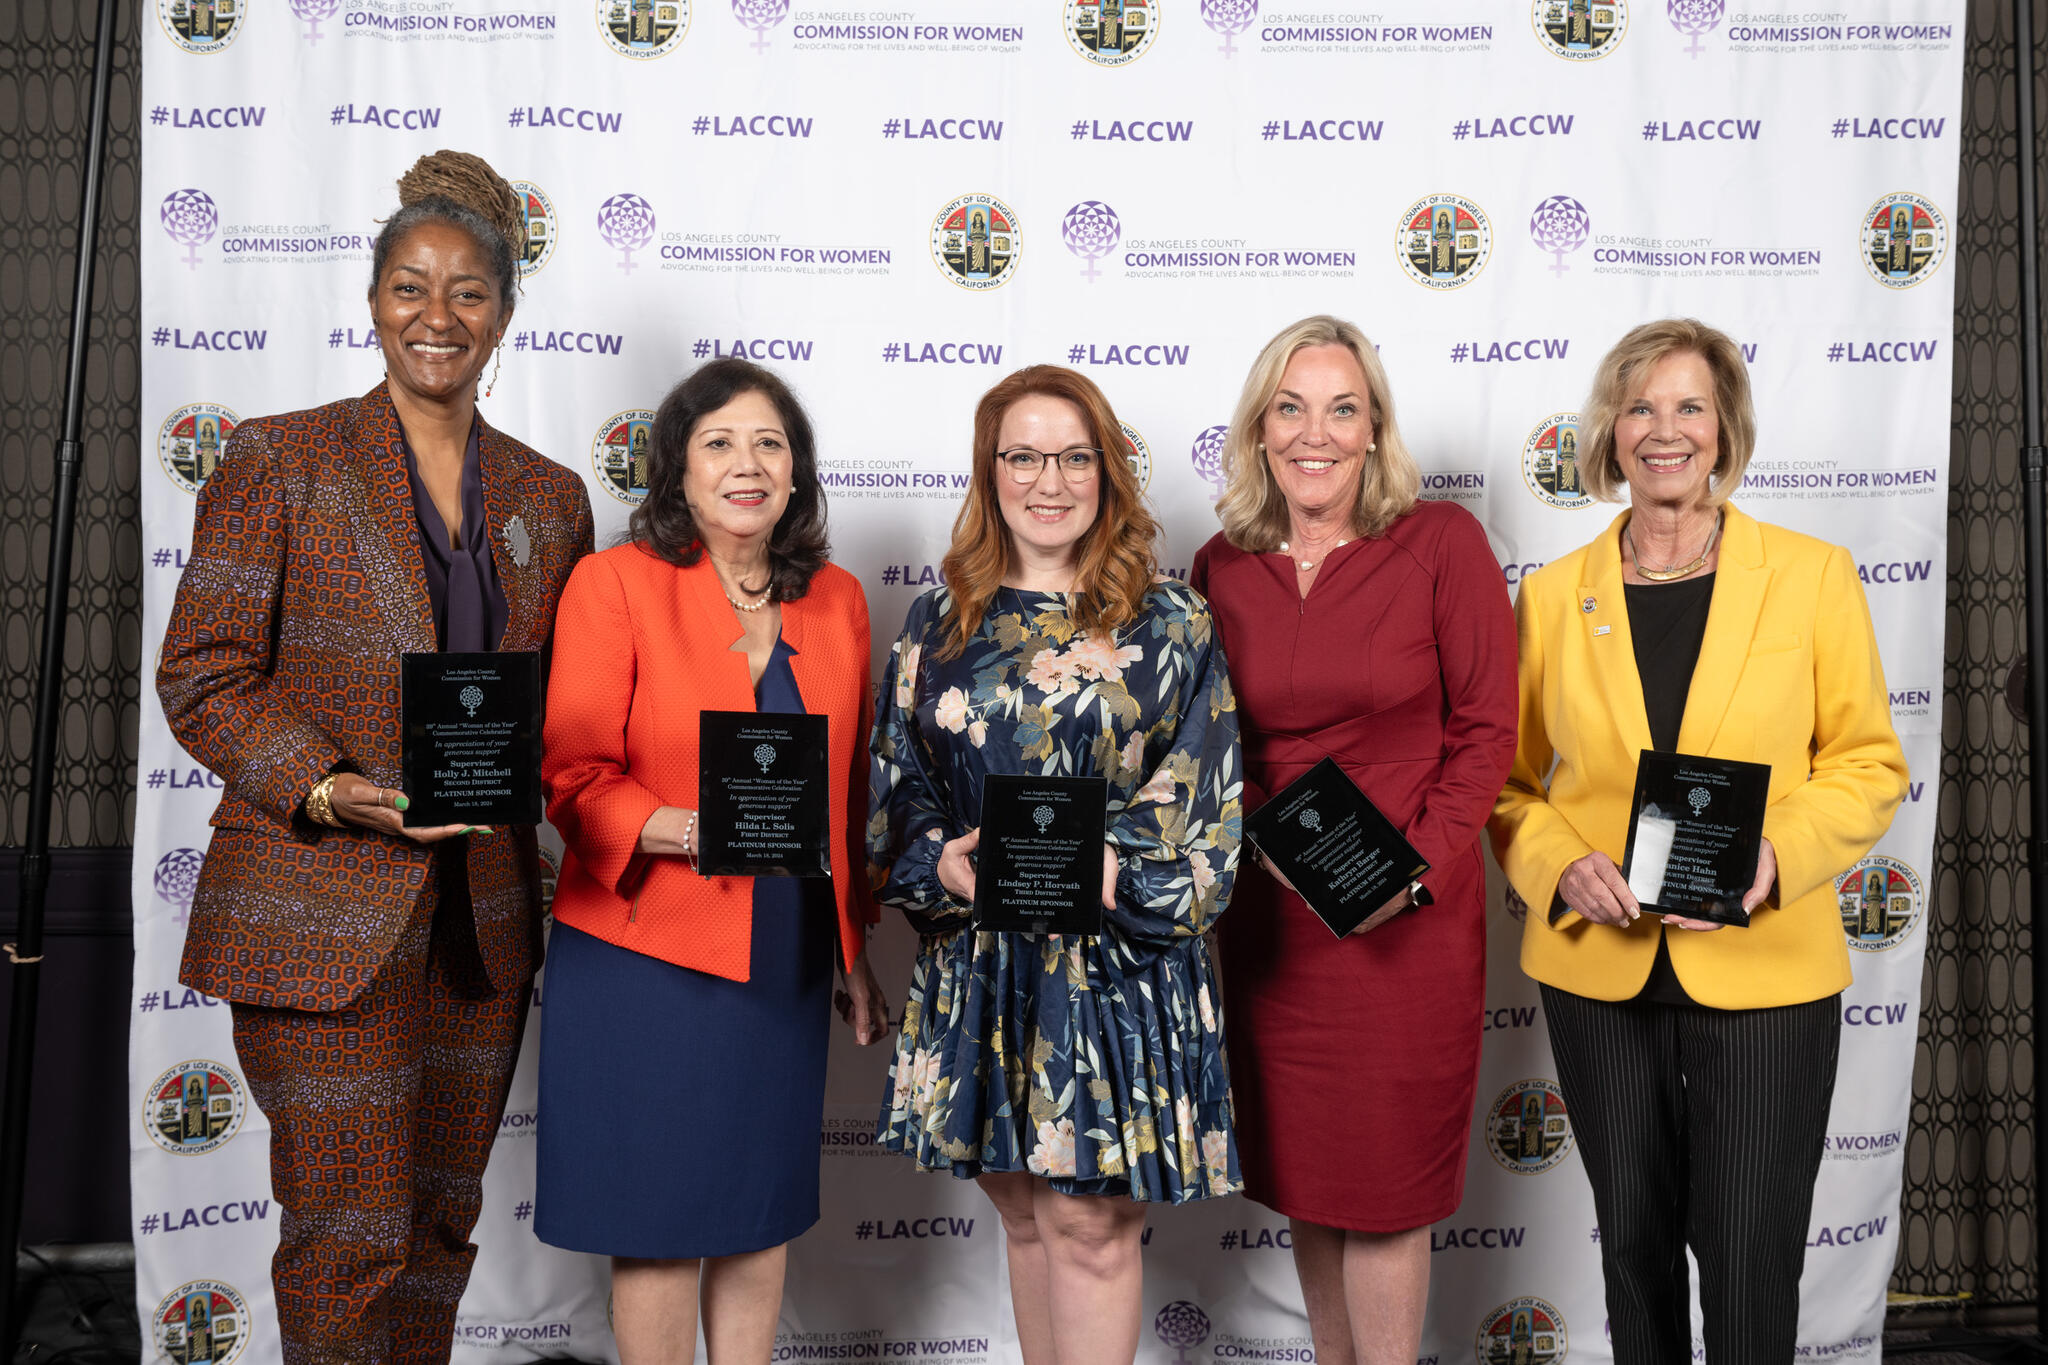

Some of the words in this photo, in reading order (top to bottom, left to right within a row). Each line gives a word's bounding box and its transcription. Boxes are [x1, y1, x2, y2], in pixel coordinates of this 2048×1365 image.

[345, 12, 448, 32] COMMISSION
[454, 17, 487, 32] FOR
[489, 14, 556, 30] WOMEN
[795, 13, 813, 21] LOS
[818, 13, 865, 21] ANGELES
[869, 13, 914, 22] COUNTY
[1263, 14, 1282, 23] LOS
[1286, 14, 1333, 23] ANGELES
[1337, 14, 1383, 24] COUNTY
[793, 25, 909, 40] COMMISSION
[914, 26, 948, 40] FOR
[953, 26, 1023, 41] WOMEN
[1261, 27, 1377, 42] COMMISSION
[1382, 27, 1417, 41] FOR
[1422, 26, 1492, 41] WOMEN
[1728, 26, 1841, 42] COMMISSION
[1847, 26, 1880, 40] FOR
[1885, 24, 1951, 40] WOMEN
[182, 41, 225, 53] CALIFORNIA
[618, 45, 665, 58] CALIFORNIA
[1555, 47, 1602, 59] CALIFORNIA
[1087, 52, 1133, 65] CALIFORNIA
[150, 105, 265, 129] #LACCW
[330, 103, 441, 130] #LACCW
[508, 105, 622, 133] #LACCW
[692, 115, 813, 137] #LACCW
[883, 119, 1003, 141] #LACCW
[1071, 120, 1193, 141] #LACCW
[1262, 120, 1383, 141] #LACCW
[1453, 115, 1574, 140] #LACCW
[1642, 120, 1761, 141] #LACCW
[1832, 117, 1945, 138] #LACCW
[936, 198, 961, 226] COUNTY
[963, 196, 973, 205] OF
[976, 196, 991, 204] LOS
[991, 199, 1017, 228] ANGELES
[1401, 198, 1427, 227] COUNTY
[1429, 196, 1440, 205] OF
[1442, 196, 1456, 204] LOS
[1457, 199, 1485, 226] ANGELES
[223, 225, 239, 235] LOS
[244, 225, 288, 234] ANGELES
[293, 224, 330, 233] COUNTY
[661, 233, 680, 242] LOS
[685, 234, 732, 242] ANGELES
[737, 234, 780, 243] COUNTY
[223, 238, 327, 253] COMMISSION
[330, 236, 362, 250] FOR
[1126, 240, 1145, 248] LOS
[1149, 240, 1197, 248] ANGELES
[1201, 240, 1246, 248] COUNTY
[1595, 235, 1615, 245] LOS
[1619, 236, 1662, 247] ANGELES
[1666, 237, 1712, 248] COUNTY
[661, 246, 775, 262] COMMISSION
[781, 248, 814, 262] FOR
[820, 249, 890, 264] WOMEN
[1125, 252, 1239, 267] COMMISSION
[1245, 253, 1279, 266] FOR
[1284, 252, 1355, 267] WOMEN
[1594, 249, 1706, 266] COMMISSION
[1711, 251, 1744, 265] FOR
[1750, 250, 1820, 265] WOMEN
[955, 276, 1000, 289] CALIFORNIA
[1421, 276, 1467, 289] CALIFORNIA
[1880, 274, 1920, 288] CALIFORNIA
[152, 327, 267, 350] #LACCW
[515, 330, 622, 356] #LACCW
[692, 339, 813, 361] #LACCW
[883, 342, 1001, 365] #LACCW
[1068, 345, 1189, 366] #LACCW
[1451, 339, 1569, 362] #LACCW
[1827, 341, 1937, 362] #LACCW
[868, 460, 913, 470] COUNTY
[1792, 461, 1838, 470] COUNTY
[913, 473, 947, 488] FOR
[1838, 473, 1869, 487] FOR
[1872, 468, 1936, 486] WOMEN
[434, 770, 459, 778] Holly
[461, 770, 470, 778] J.
[472, 769, 511, 777] Mitchell
[744, 813, 786, 821] Supervisor
[1333, 849, 1365, 876] Supervisor
[1669, 853, 1712, 865] Supervisor
[1328, 863, 1358, 890] Kathryn
[1357, 848, 1381, 871] Barger
[1666, 864, 1690, 872] anice
[1693, 866, 1717, 876] Hahn
[998, 880, 1031, 888] Lindsey
[1339, 876, 1371, 904] PLATINUM
[1368, 860, 1394, 881] SPONSOR
[1688, 885, 1723, 895] SPONSOR
[150, 1065, 177, 1097] COUNTY
[180, 1062, 192, 1073] OF
[194, 1061, 209, 1072] LOS
[209, 1064, 240, 1089] ANGELES
[171, 1139, 221, 1154] CALIFORNIA
[1836, 1131, 1900, 1150] WOMEN
[141, 1200, 269, 1235] #LACCW
[856, 1217, 974, 1240] #LACCW
[1431, 1227, 1525, 1253] LACCW
[772, 1342, 879, 1362] COMMISSION
[884, 1341, 916, 1356] FOR
[921, 1338, 988, 1354] WOMEN
